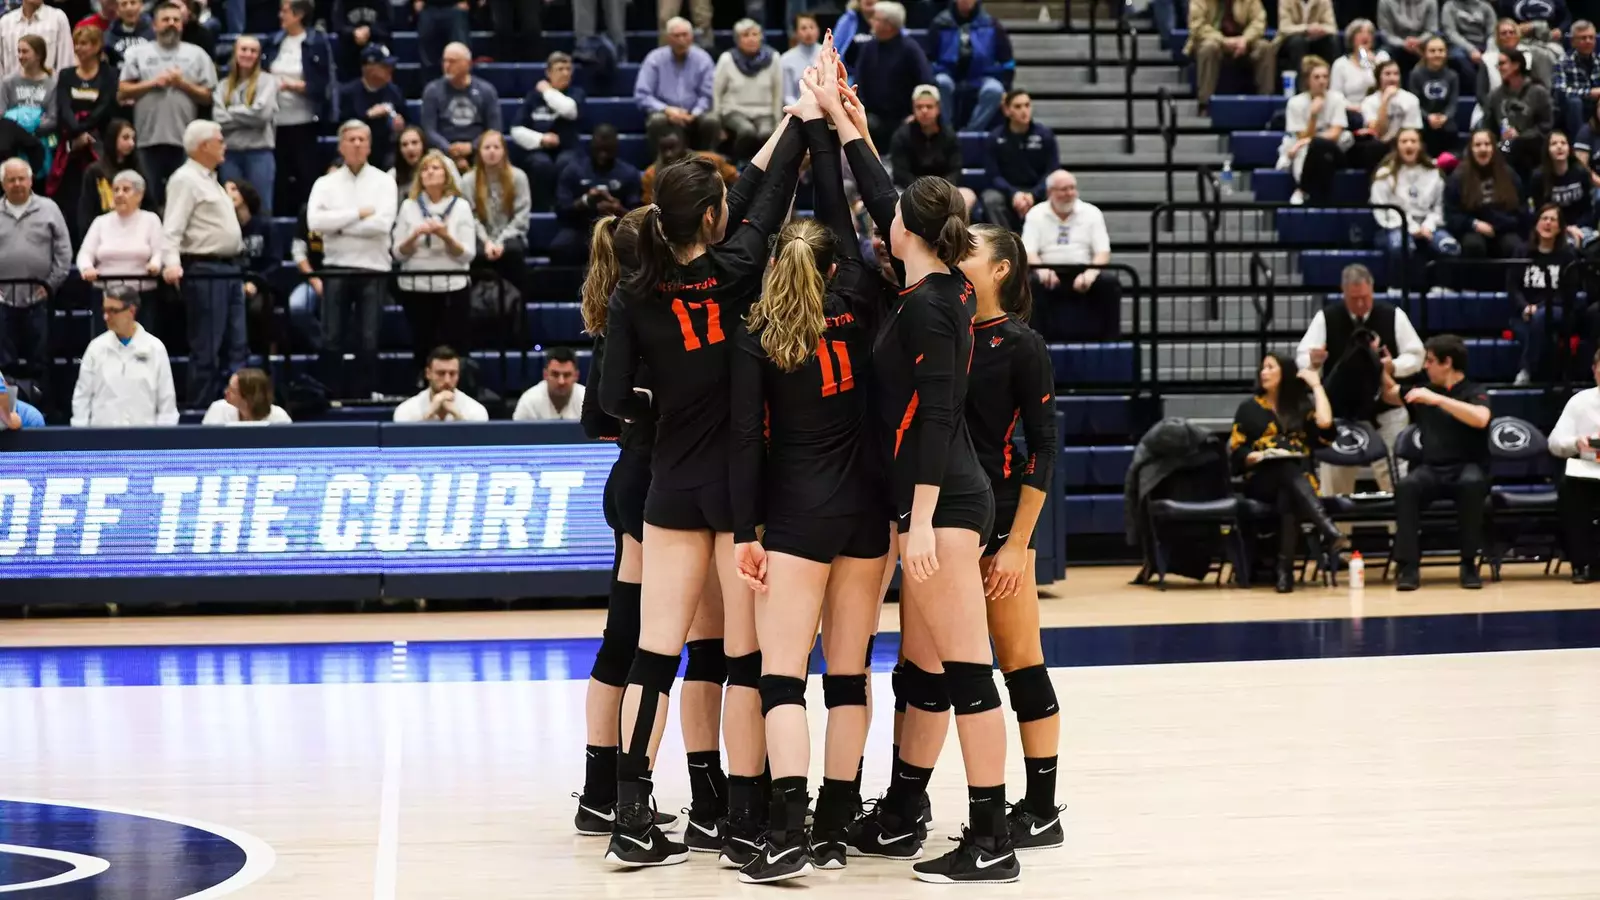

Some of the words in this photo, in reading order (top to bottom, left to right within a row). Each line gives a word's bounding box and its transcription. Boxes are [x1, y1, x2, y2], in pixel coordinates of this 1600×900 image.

[671, 298, 725, 352] 17
[816, 338, 855, 397] 11
[0, 477, 129, 556] OFF
[150, 474, 298, 554] THE
[316, 471, 587, 552] COURT
